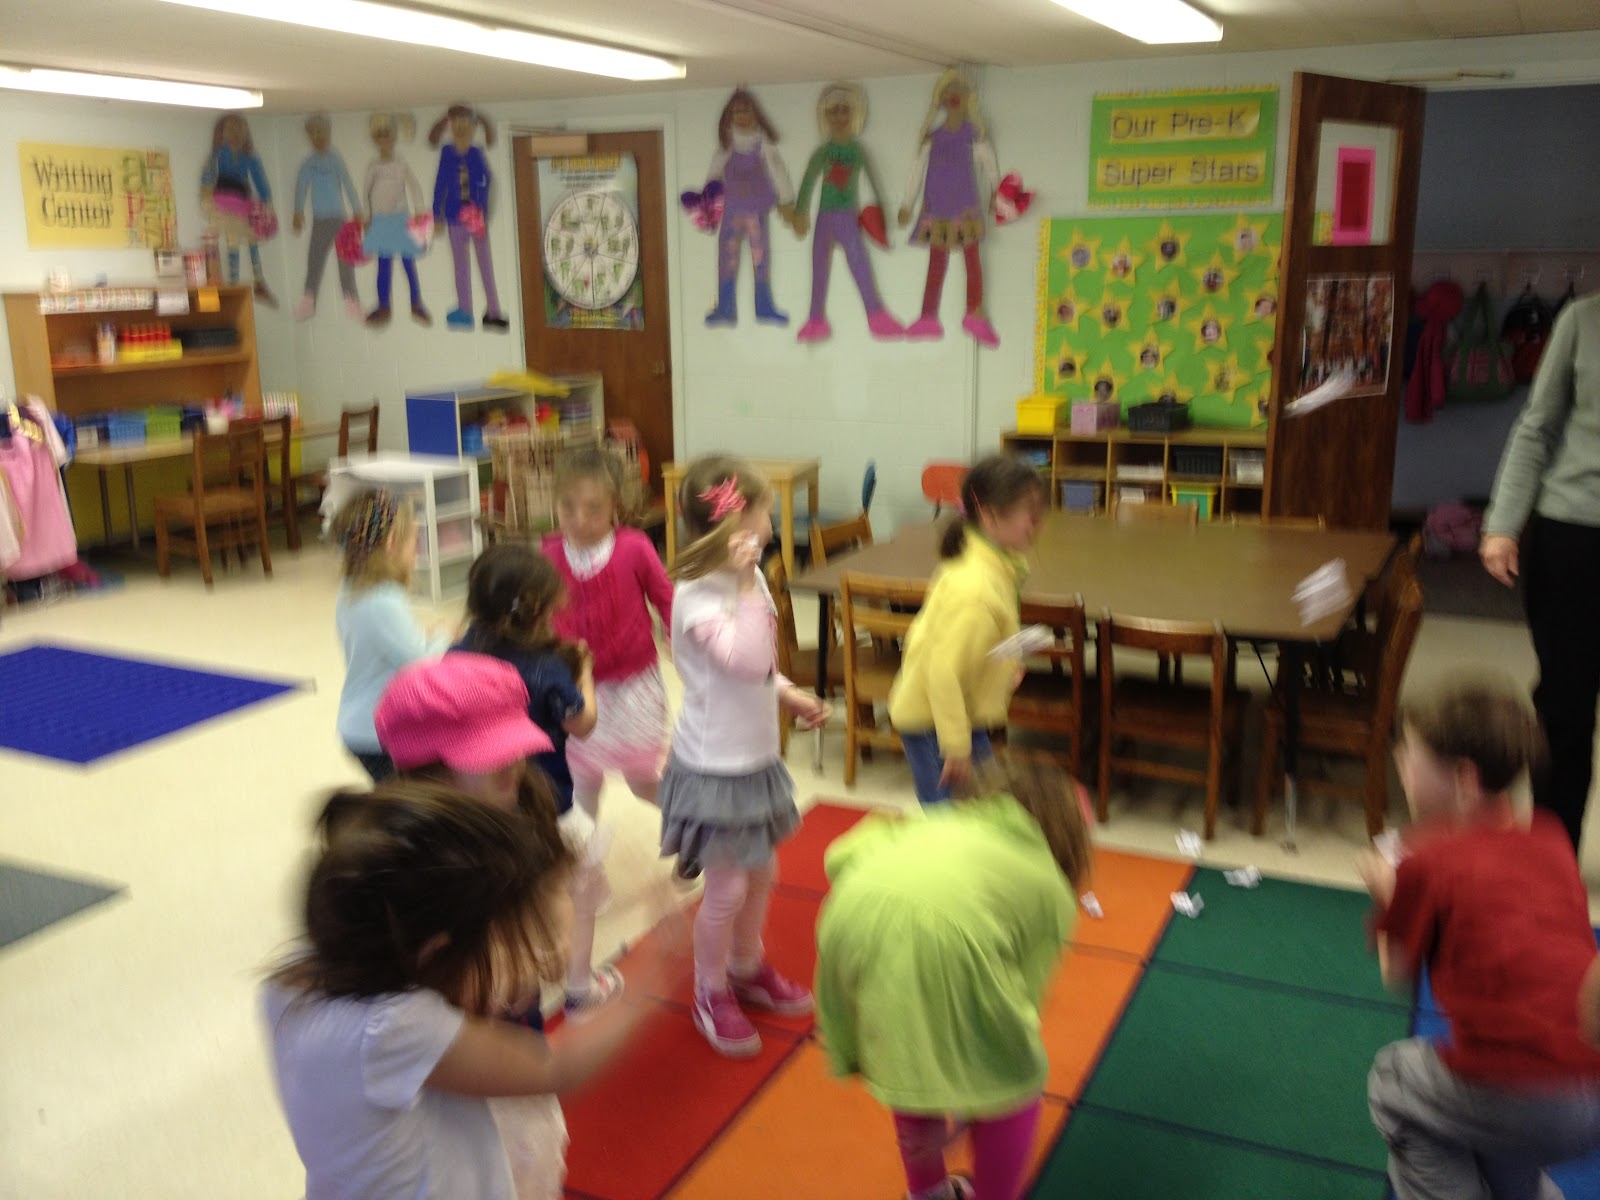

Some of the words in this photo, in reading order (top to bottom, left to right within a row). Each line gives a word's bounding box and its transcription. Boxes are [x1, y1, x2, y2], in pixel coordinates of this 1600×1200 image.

[1112, 114, 1157, 139] Our
[1171, 106, 1248, 135] Pre-K
[32, 155, 113, 201] Writing
[1103, 159, 1175, 190] Super
[1189, 156, 1259, 185] Stars
[41, 193, 114, 229] Center
